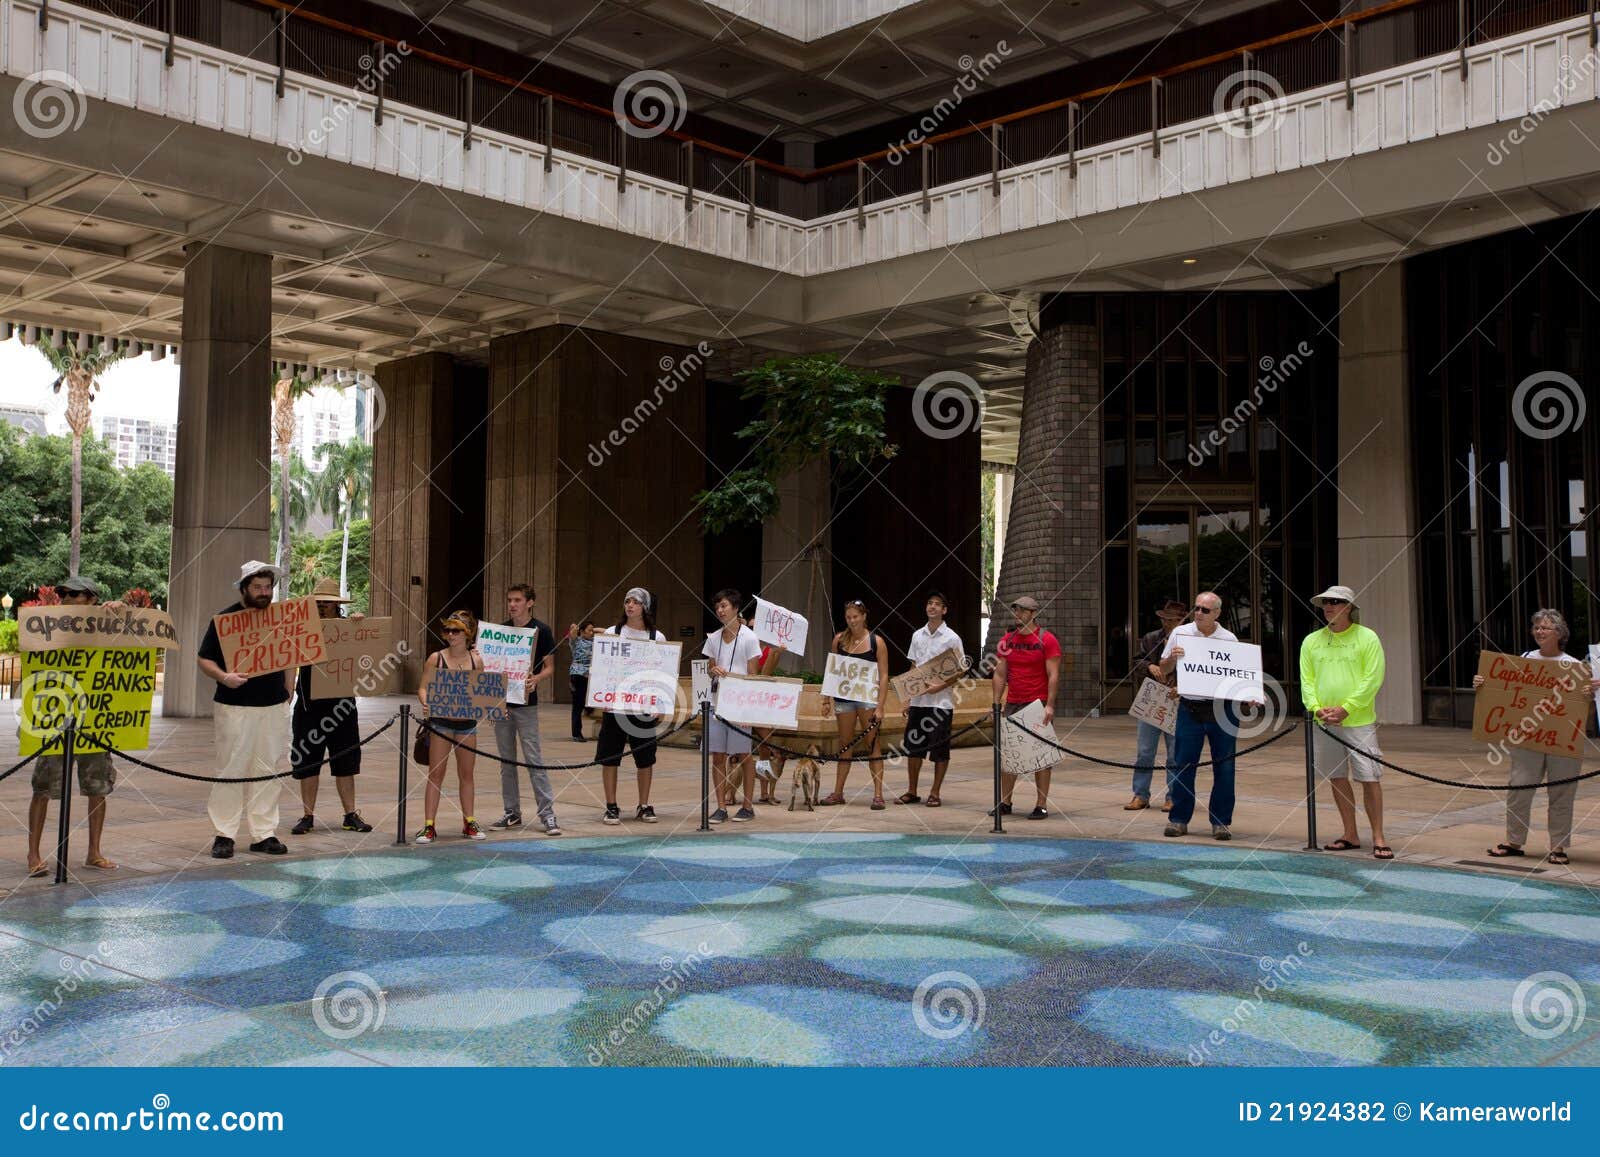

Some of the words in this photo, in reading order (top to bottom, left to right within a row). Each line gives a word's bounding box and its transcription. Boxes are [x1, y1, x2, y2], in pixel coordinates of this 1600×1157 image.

[219, 600, 309, 637] CAPITALISM
[240, 633, 260, 647] IS
[270, 623, 309, 639] THE
[355, 627, 380, 640] are
[480, 629, 523, 645] MONEY
[232, 634, 321, 674] CRISIS
[598, 641, 631, 657] THE
[1209, 651, 1231, 661] TAX
[27, 651, 96, 667] MONEY
[102, 650, 149, 670] FROM
[435, 670, 469, 685] MAKE
[478, 673, 502, 686] OUR
[1184, 663, 1256, 680] WALLSTREET
[92, 672, 153, 692] BANKS
[428, 682, 469, 695] FUTURE
[472, 685, 505, 697] WORTH
[34, 693, 60, 712] TO
[66, 693, 113, 711] YOUR
[32, 713, 91, 730] LOCL
[94, 710, 150, 729] CREDIT
[430, 706, 483, 718] FORWARD
